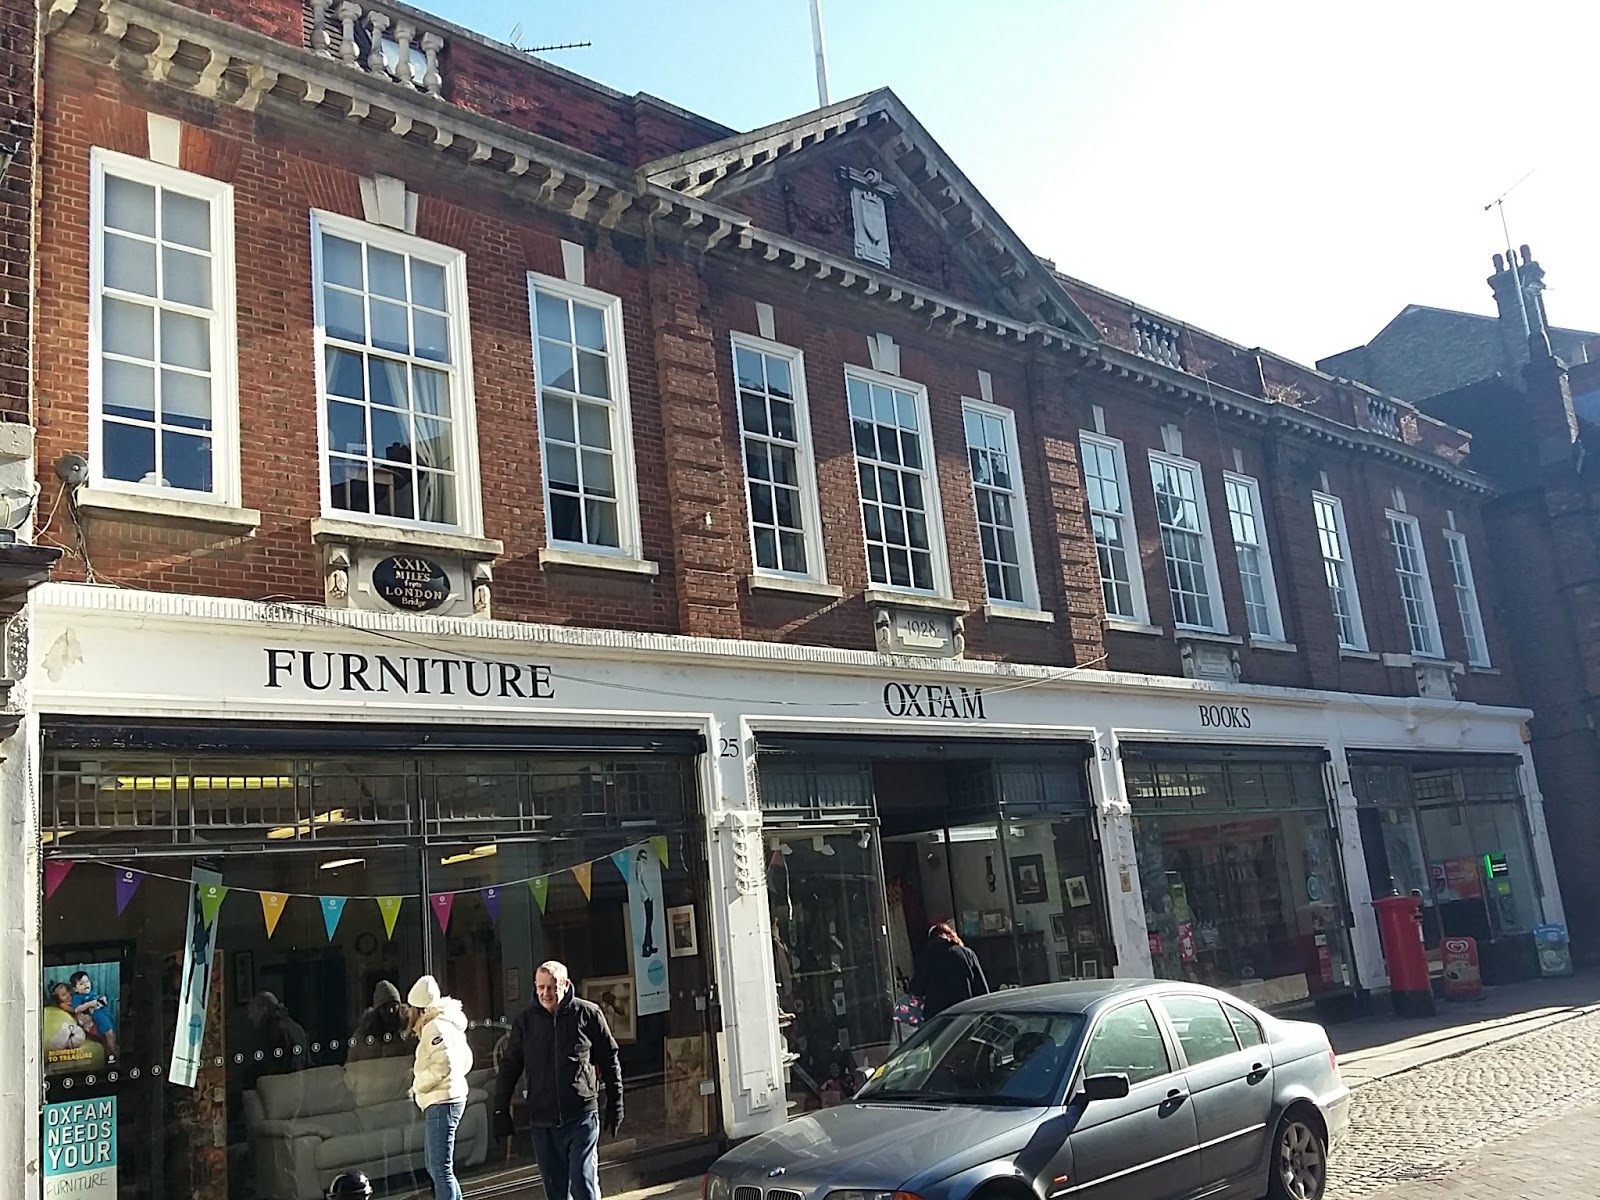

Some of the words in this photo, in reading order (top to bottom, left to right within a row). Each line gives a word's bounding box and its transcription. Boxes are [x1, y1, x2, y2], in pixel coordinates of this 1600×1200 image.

[392, 557, 432, 573] XXIX
[395, 570, 431, 582] MILES
[385, 586, 442, 600] LONDON
[401, 596, 427, 607] Bridge
[263, 648, 555, 699] FURNITURE
[883, 682, 987, 719] OXFAM
[1198, 705, 1251, 729] BOOKS
[718, 737, 739, 758] 25
[1099, 746, 1112, 762] 29
[59, 1052, 93, 1062] TREASURE
[47, 1100, 113, 1127] OXFAM
[47, 1121, 112, 1148] NEEDS
[48, 1140, 111, 1171] YOUR
[46, 1171, 109, 1197] FURNITURE
